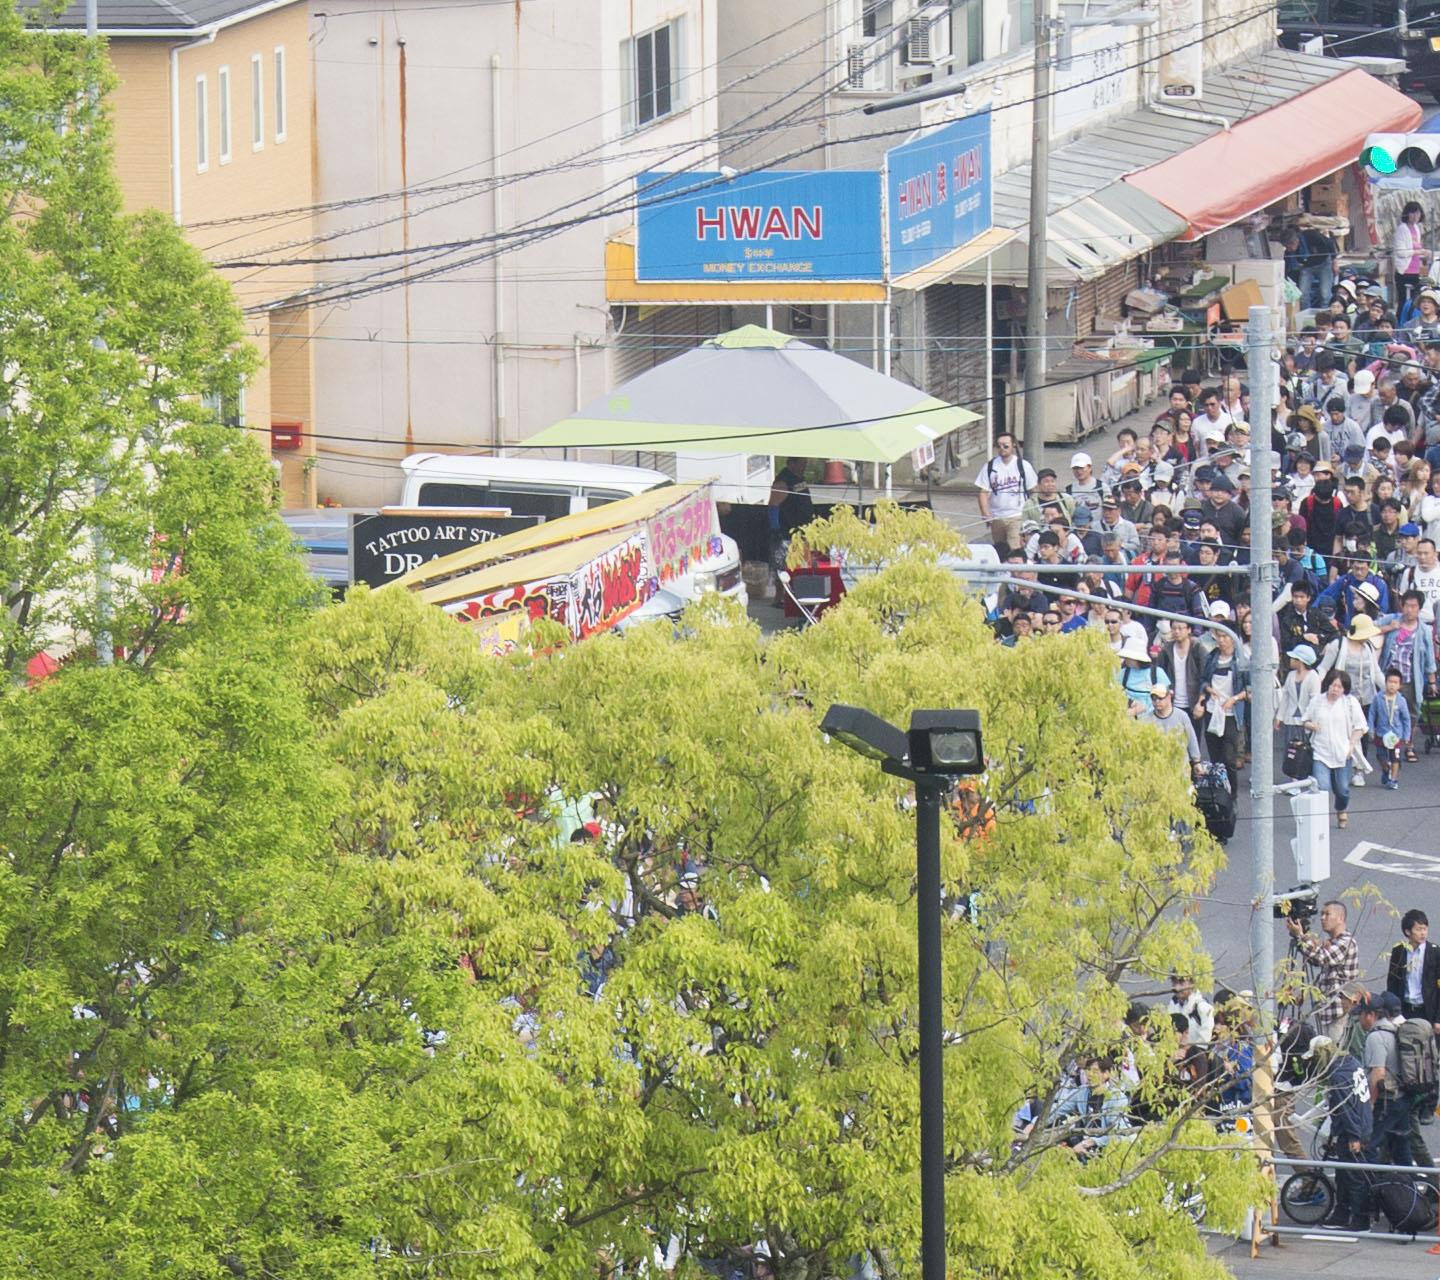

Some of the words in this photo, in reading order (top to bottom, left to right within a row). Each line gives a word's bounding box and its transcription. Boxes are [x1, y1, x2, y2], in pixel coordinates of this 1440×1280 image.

[696, 206, 824, 241] HWAN
[703, 262, 745, 274] MONEY
[748, 261, 814, 273] EXCHANGE
[366, 526, 431, 556] TATTOO
[434, 526, 468, 541] ART
